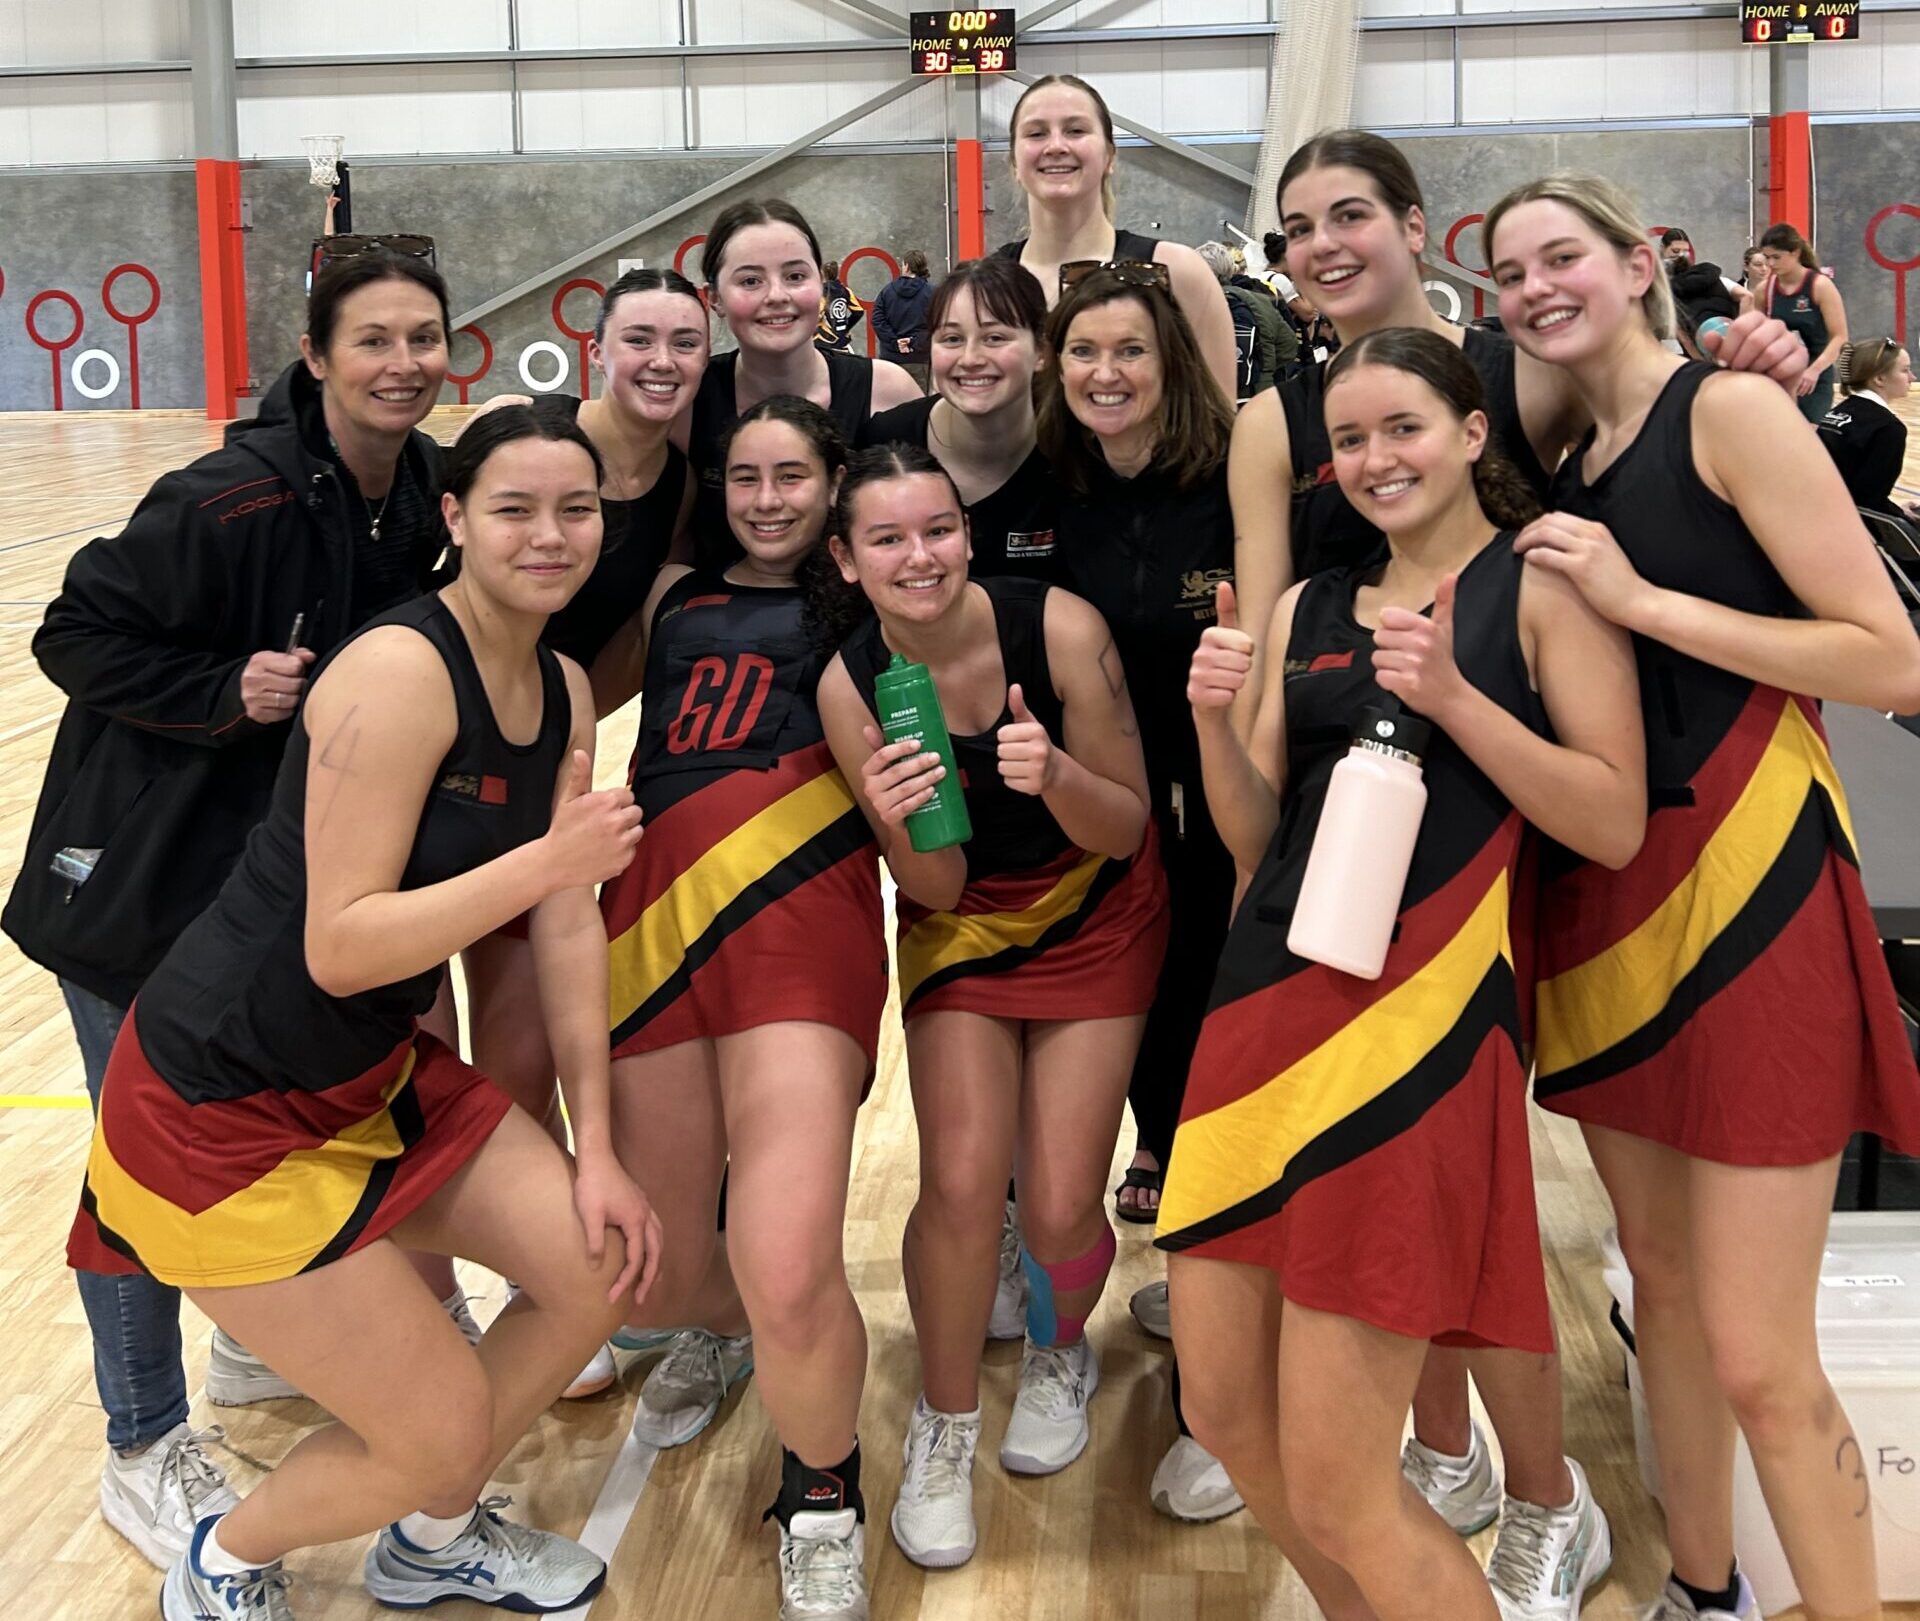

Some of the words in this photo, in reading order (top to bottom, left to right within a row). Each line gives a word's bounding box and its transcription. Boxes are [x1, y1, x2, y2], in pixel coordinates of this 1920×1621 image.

[1745, 5, 1791, 19] HOME
[1814, 3, 1859, 16] AWAY
[948, 11, 987, 31] 0:00
[1756, 19, 1771, 41] 0
[1830, 16, 1845, 38] 0
[912, 38, 952, 51] HOME
[973, 36, 1014, 49] AWAY
[924, 51, 948, 72] 30
[980, 49, 1004, 70] 38
[667, 652, 775, 755] GD
[890, 706, 918, 719] PREPARE
